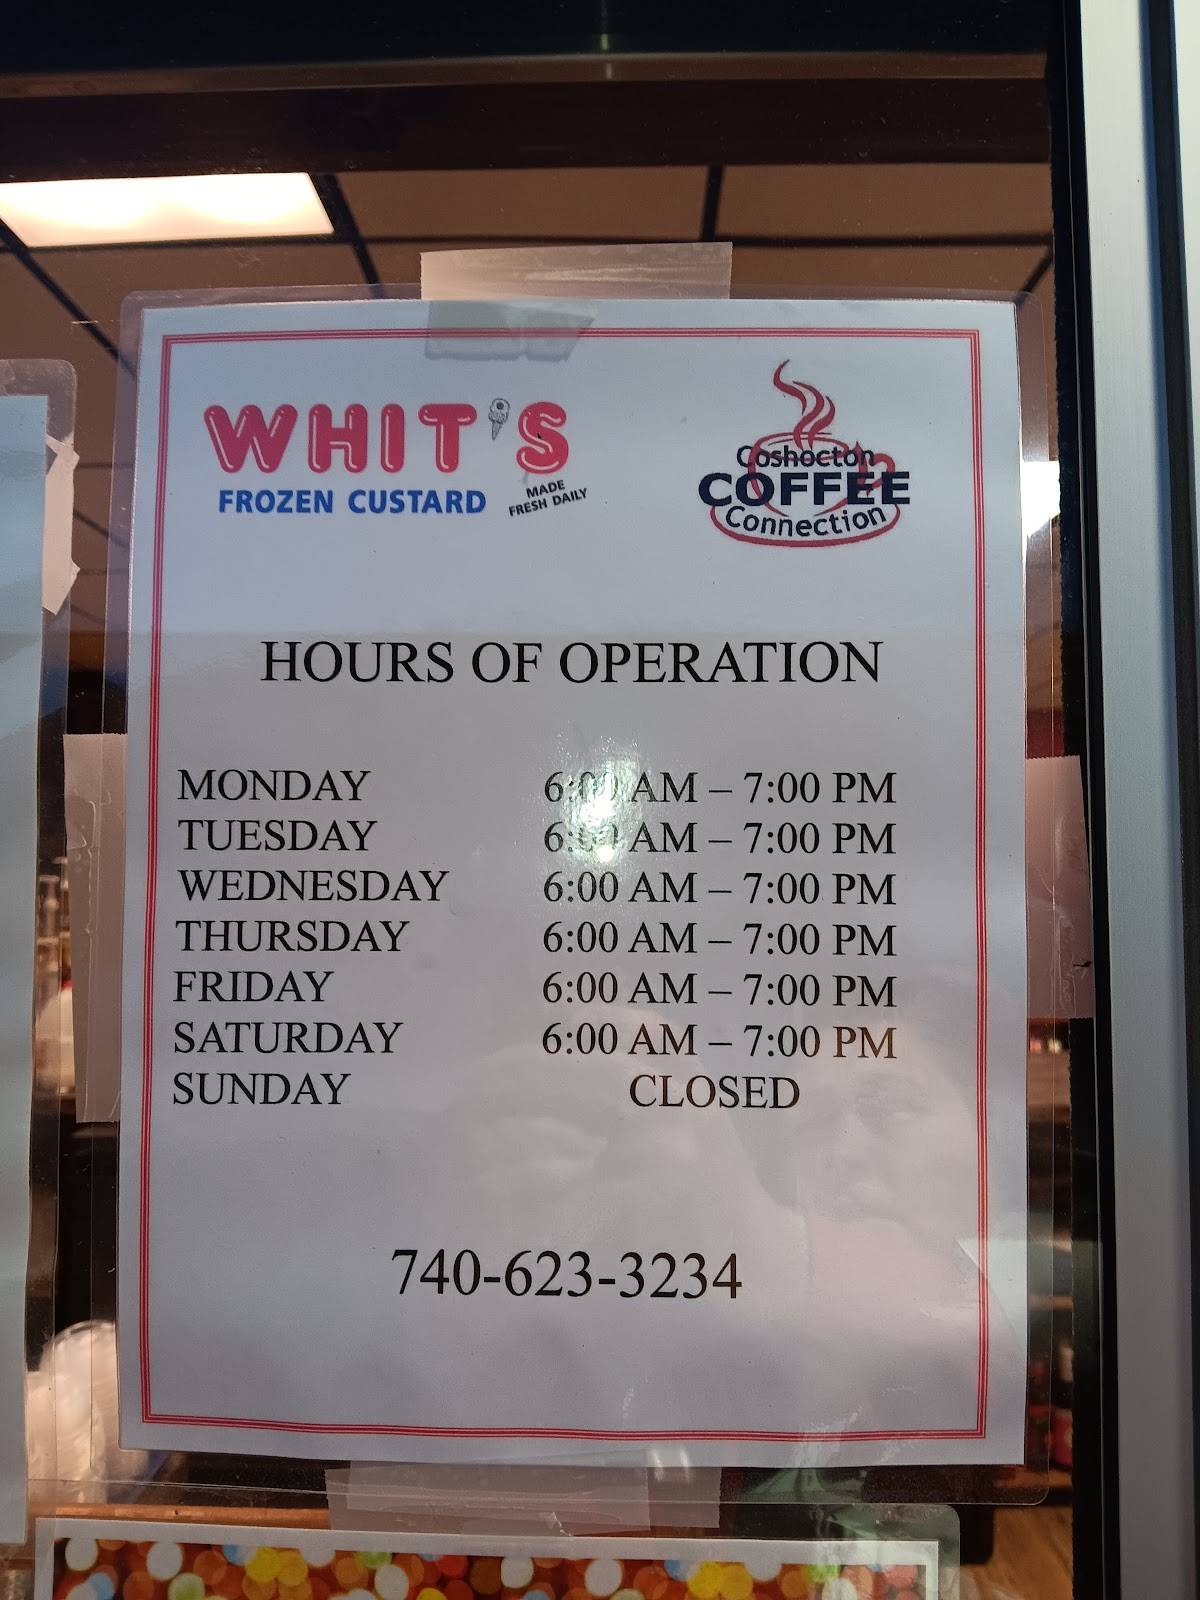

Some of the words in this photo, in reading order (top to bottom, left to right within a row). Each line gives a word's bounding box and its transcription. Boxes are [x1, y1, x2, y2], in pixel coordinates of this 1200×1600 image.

[736, 445, 876, 468] Coshocton
[219, 489, 333, 514] FROZEN
[348, 489, 487, 514] CUSTARD
[508, 498, 548, 517] FRESH
[552, 487, 587, 506] DAILY
[526, 479, 566, 499] MADE
[698, 471, 911, 507] COFFEE
[725, 505, 886, 537] Connection
[260, 641, 453, 683] HOURS
[472, 641, 542, 683] OF
[560, 641, 884, 683] OPERATION
[178, 769, 371, 800] MONDAY
[628, 771, 698, 802] AM
[744, 772, 820, 803] 7:00
[832, 772, 897, 804] PM
[178, 820, 377, 851] TUESDAY
[628, 821, 698, 853] AM
[744, 822, 820, 854] 7:00
[832, 822, 897, 855] PM
[178, 870, 449, 901] WEDNESDAY
[543, 871, 619, 903] 6:00
[628, 871, 698, 903] AM
[744, 872, 820, 904] 7:00
[832, 872, 897, 905] PM
[176, 920, 410, 952] THURSDAY
[543, 921, 619, 954] 6:00
[628, 921, 698, 954] AM
[744, 922, 820, 955] 7:00
[832, 922, 897, 956] PM
[173, 971, 334, 1002] FRIDAY
[543, 972, 619, 1005] 6:00
[628, 972, 698, 1005] AM
[744, 973, 820, 1006] 7:00
[832, 973, 897, 1007] PM
[174, 1022, 403, 1053] SATURDAY
[543, 1023, 619, 1056] 6:00
[628, 1023, 698, 1056] AM
[744, 1024, 820, 1057] 7:00
[832, 1024, 897, 1058] PM
[174, 1072, 351, 1104] SUNDAY
[630, 1075, 800, 1108] CLOSED
[392, 1249, 742, 1299] 740-623-3234
